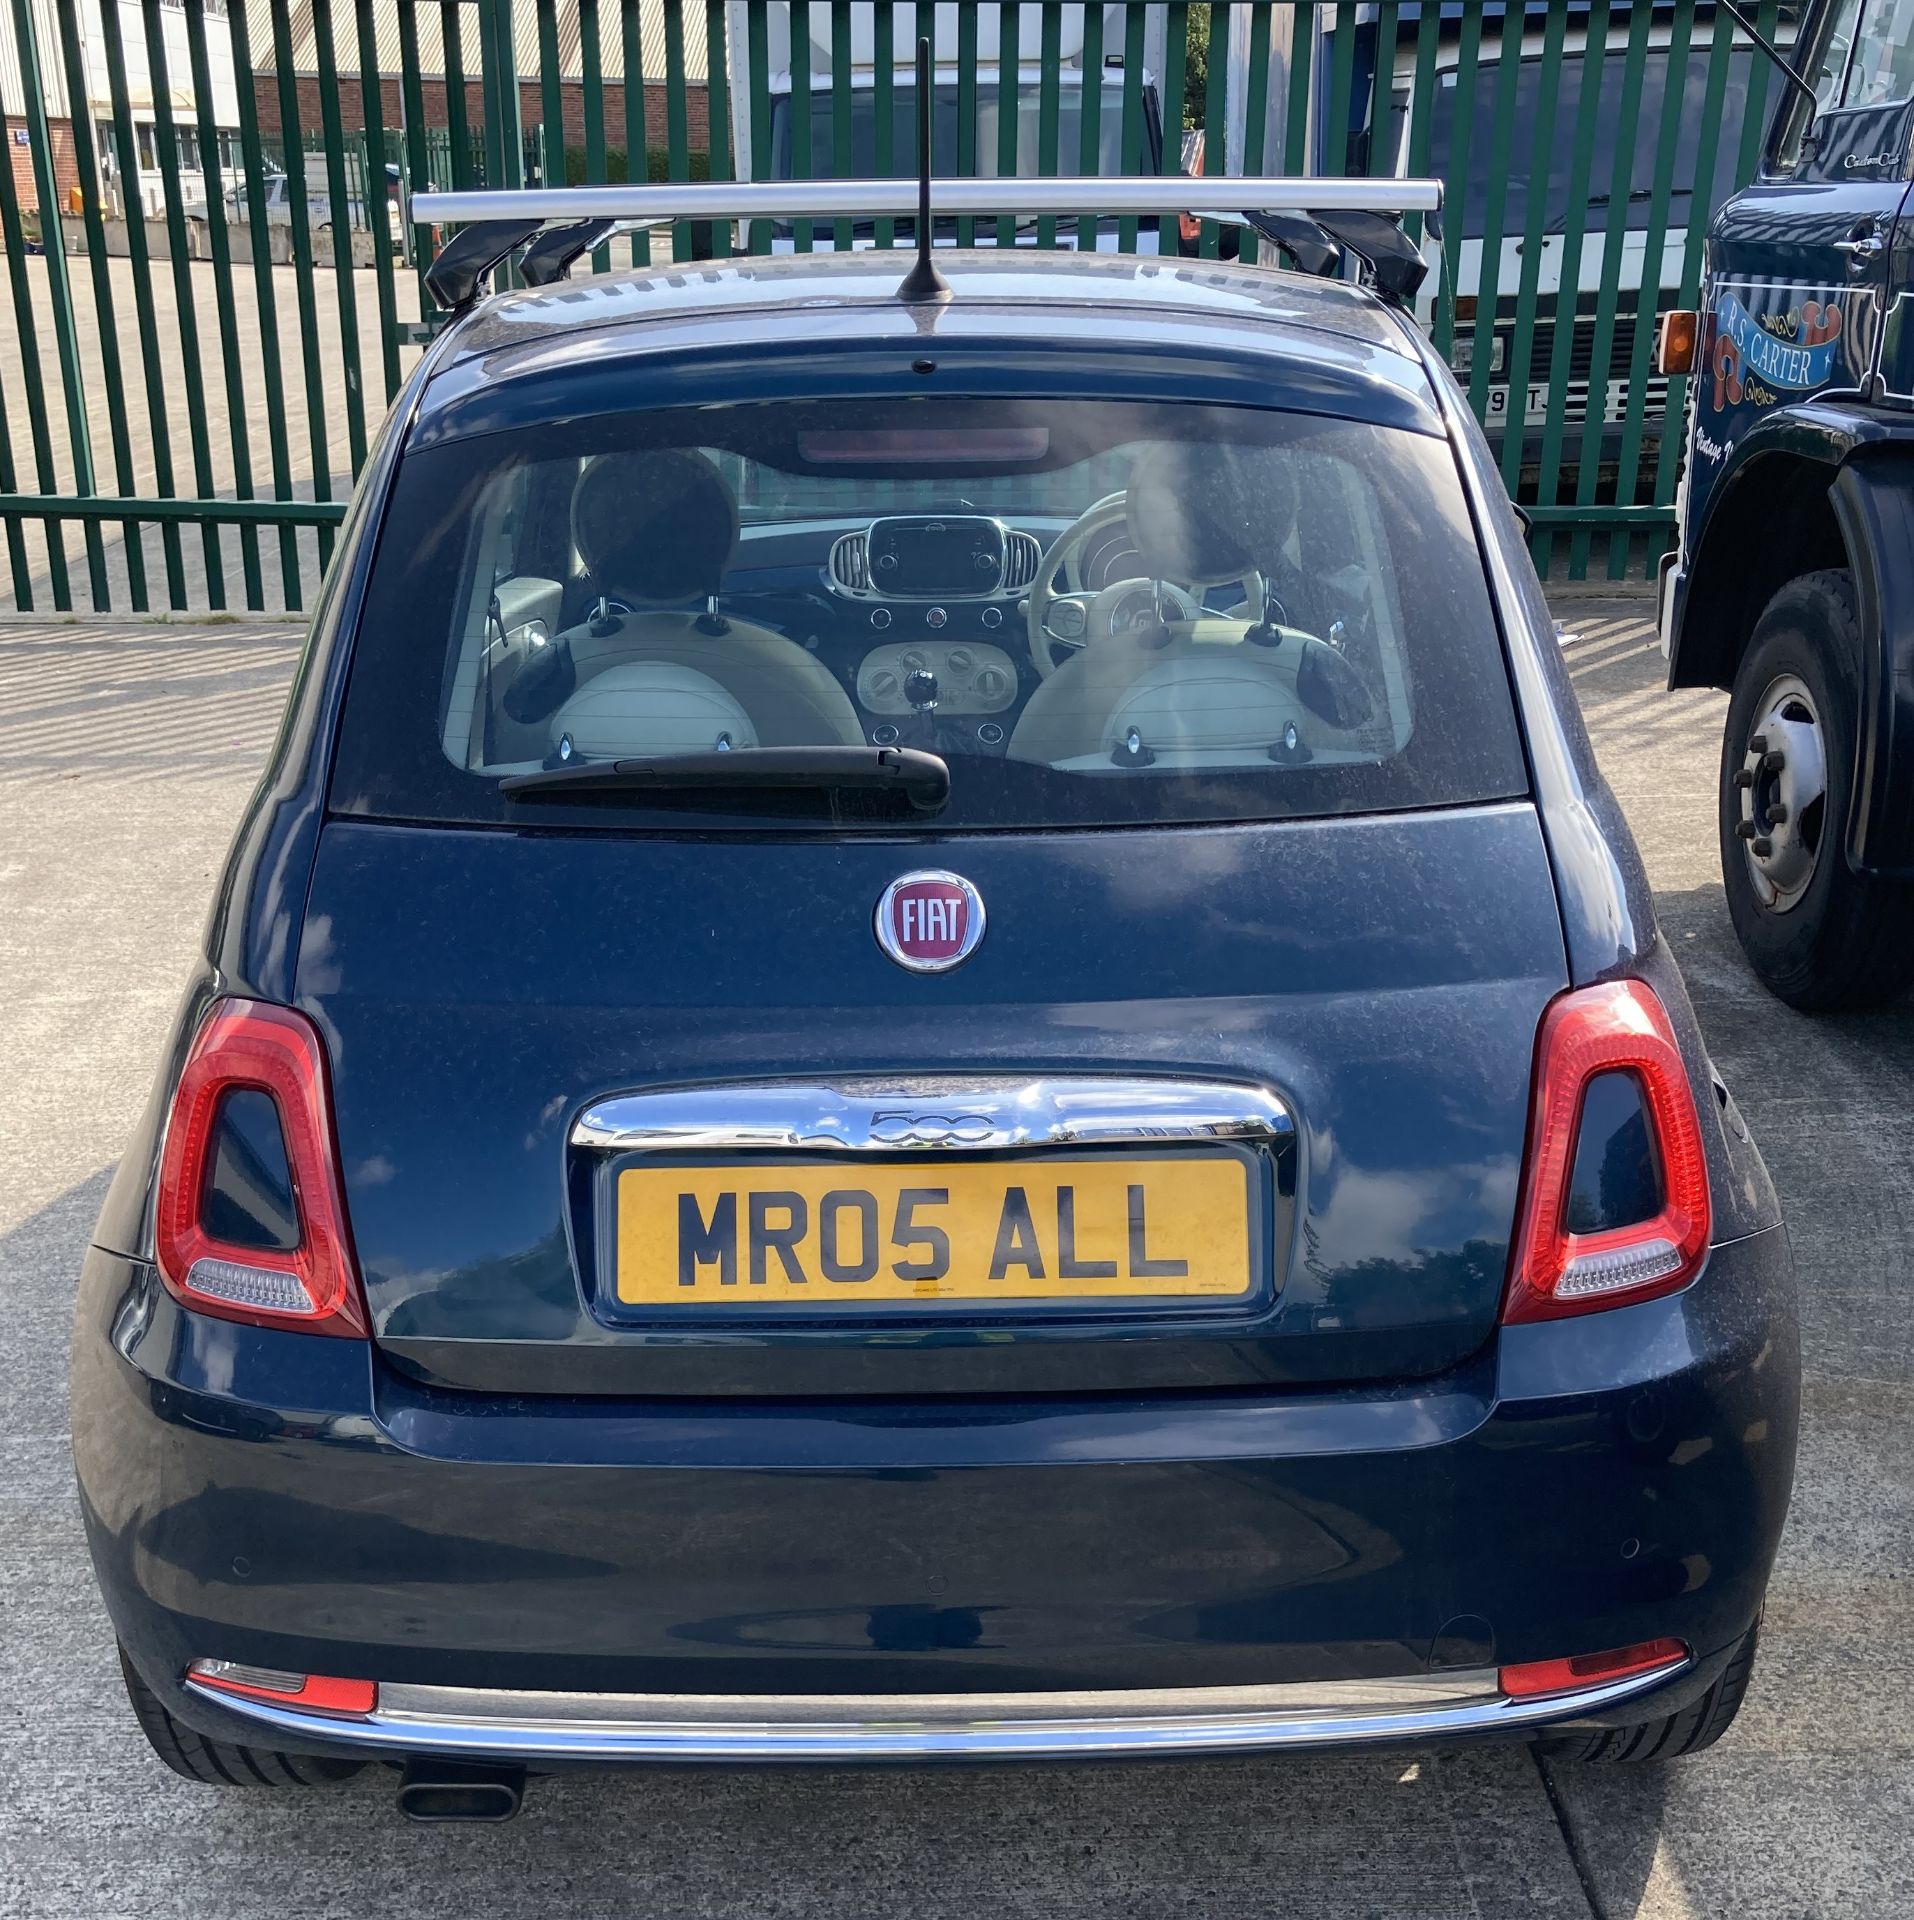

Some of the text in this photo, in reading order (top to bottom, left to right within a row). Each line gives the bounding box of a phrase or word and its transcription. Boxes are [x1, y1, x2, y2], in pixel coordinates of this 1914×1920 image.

[1750, 333, 1812, 385] CARTER
[1696, 426, 1722, 466] Vintage
[902, 898, 962, 942] FIAT
[869, 1110, 995, 1144] 500
[678, 1184, 1189, 1287] MR05 ALL
